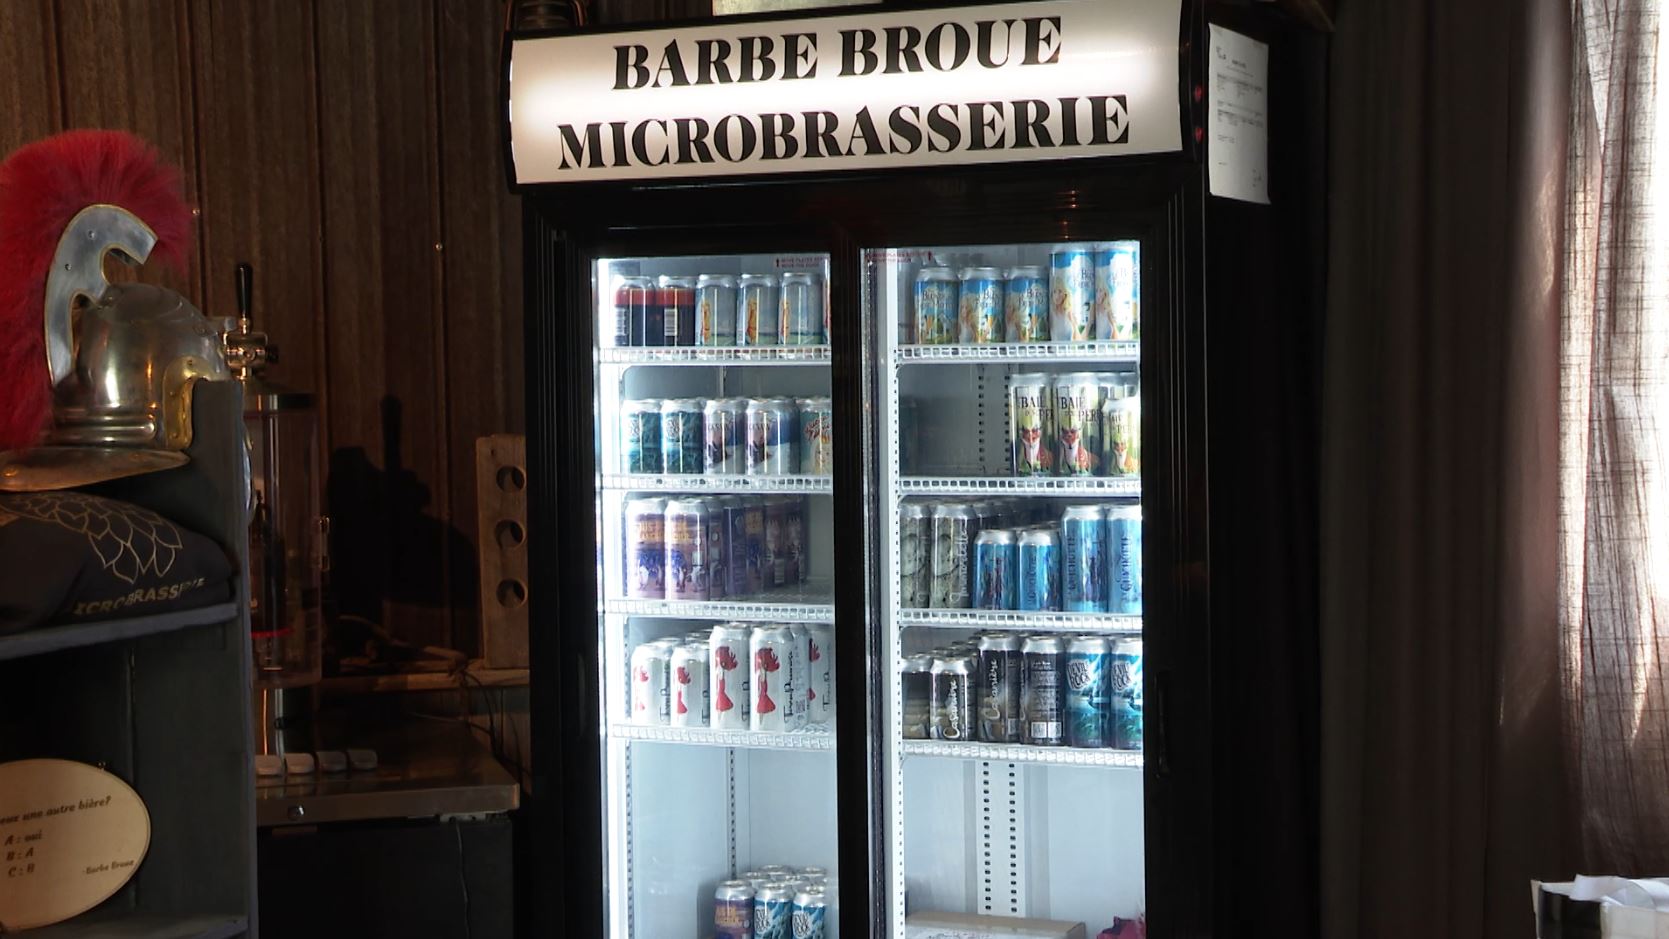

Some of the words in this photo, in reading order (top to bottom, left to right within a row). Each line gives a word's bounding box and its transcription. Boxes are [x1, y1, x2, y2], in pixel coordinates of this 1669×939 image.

[611, 32, 818, 91] BARBE
[837, 15, 1061, 78] BROUE
[557, 94, 1129, 170] MICROBRASSERIE
[46, 803, 76, 817] autre
[78, 795, 111, 810] bière?
